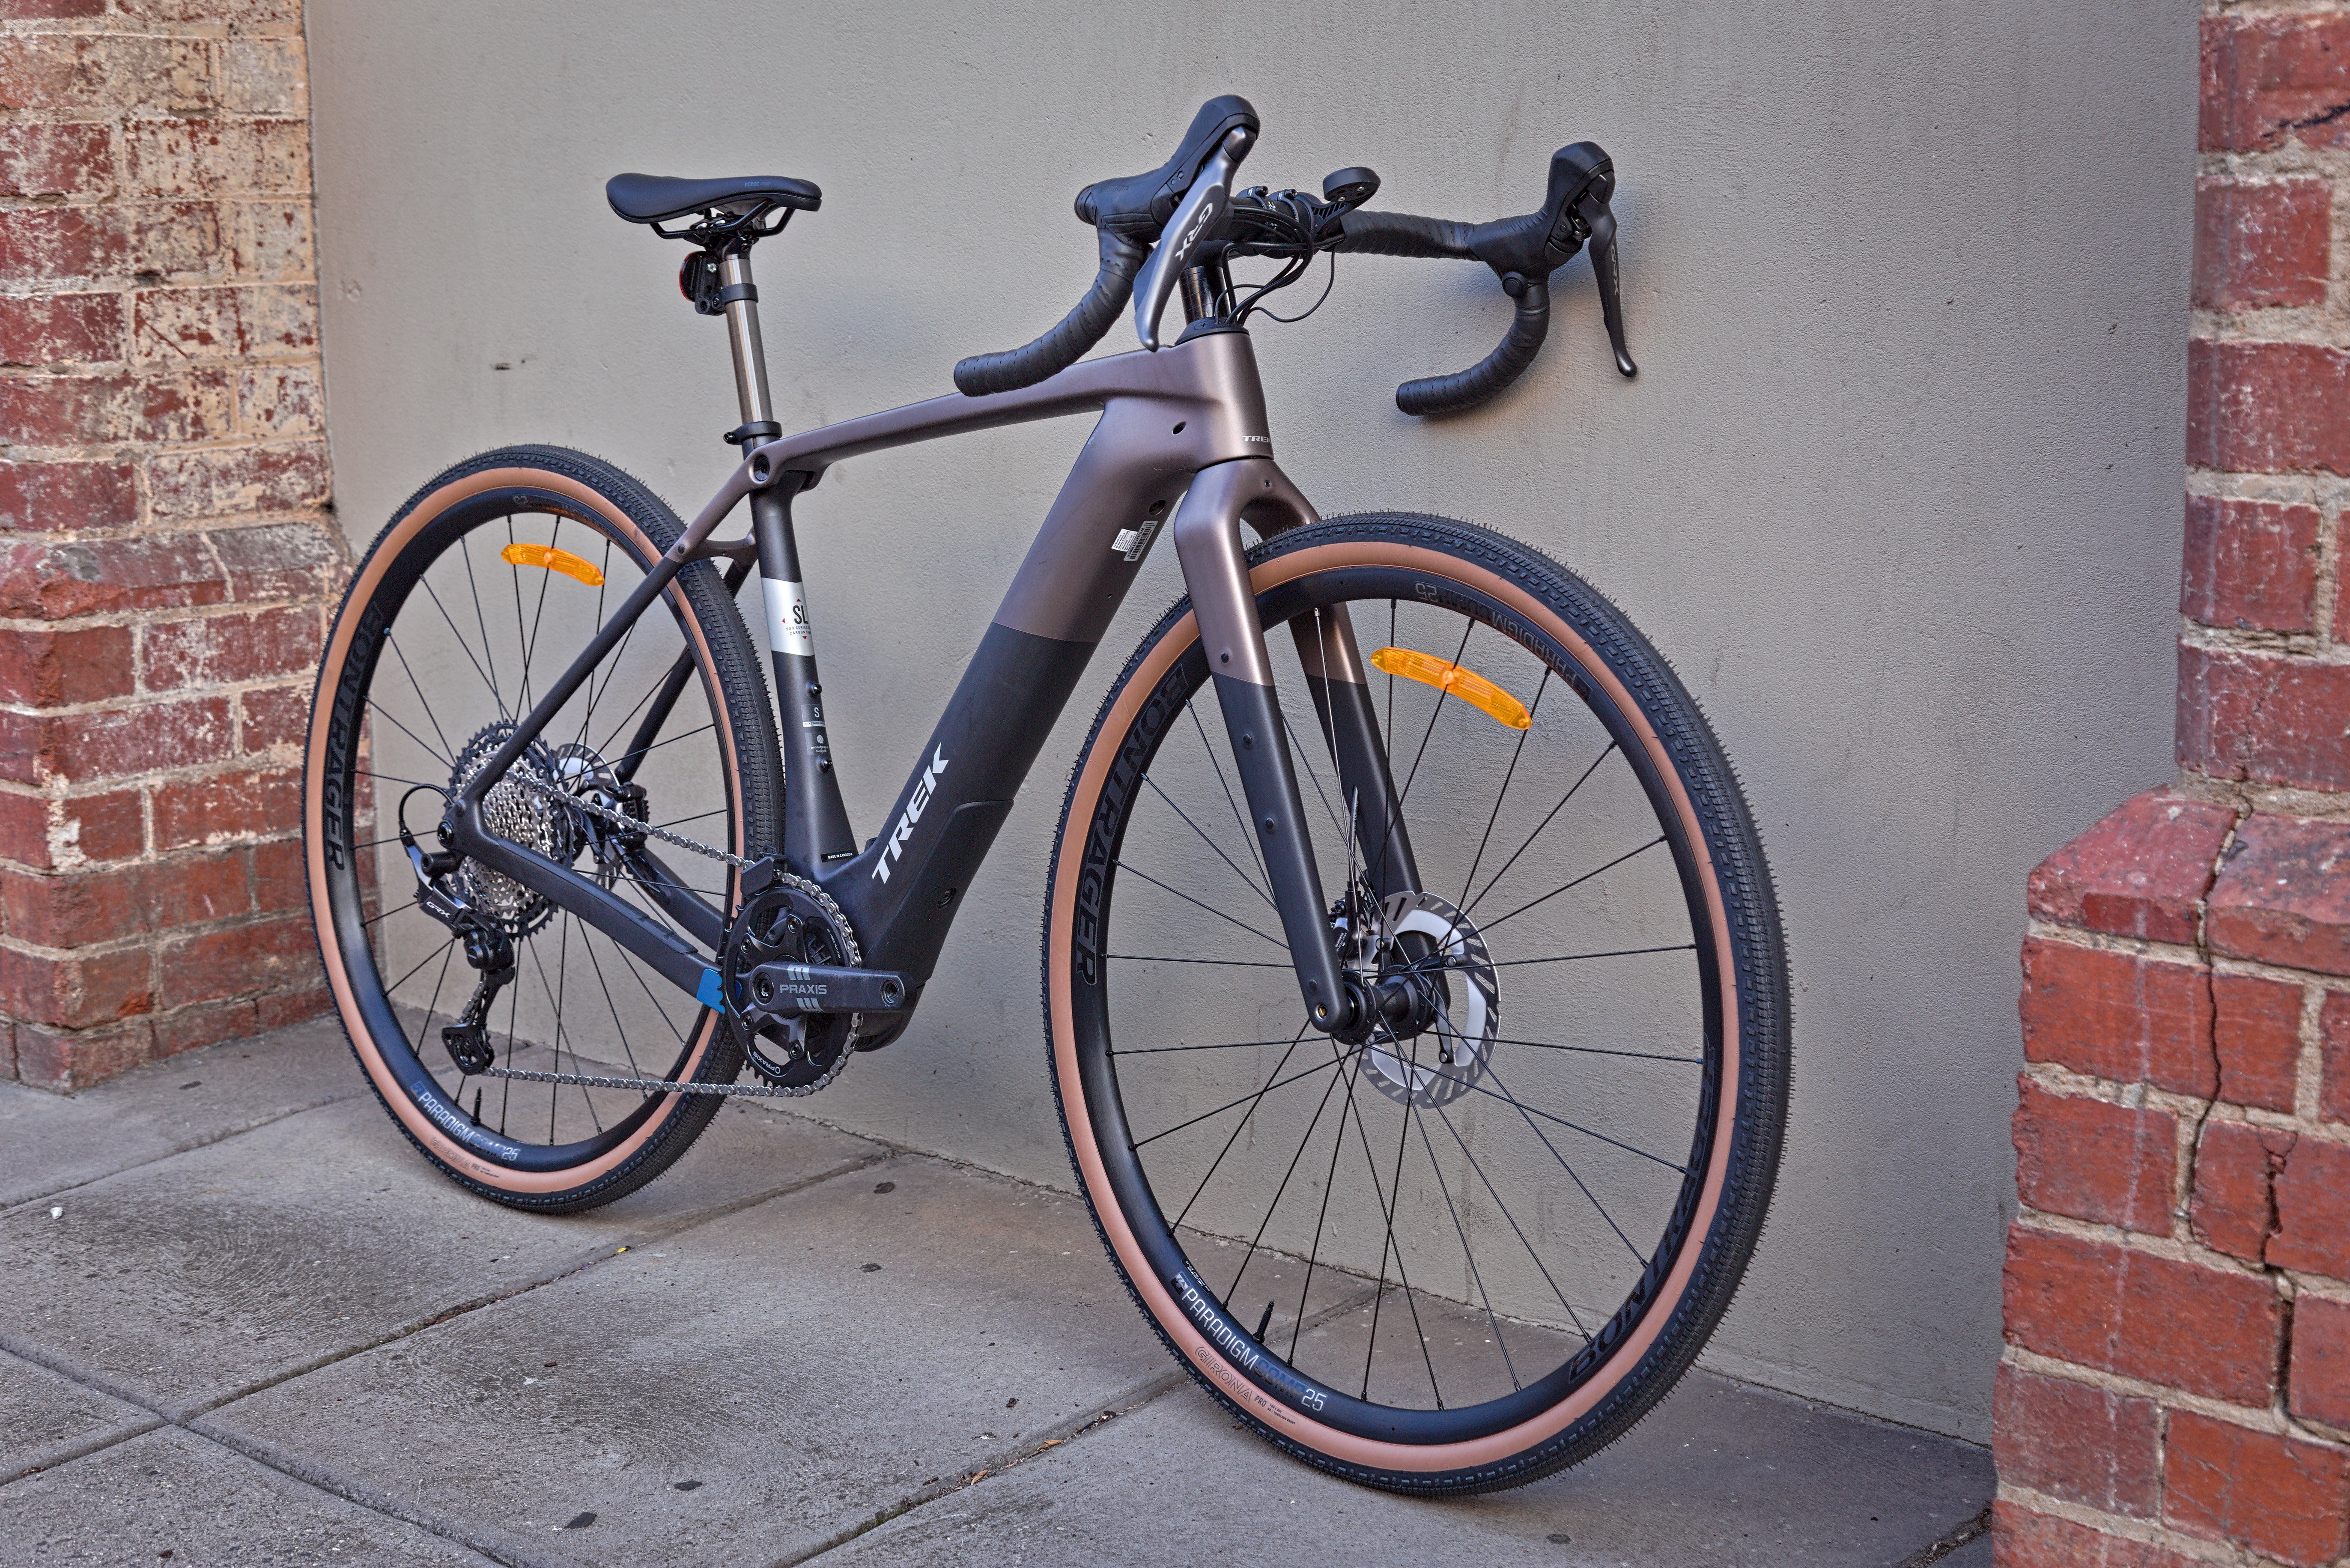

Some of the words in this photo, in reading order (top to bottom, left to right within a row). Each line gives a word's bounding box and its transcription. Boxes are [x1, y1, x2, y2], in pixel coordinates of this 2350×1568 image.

[1175, 203, 1213, 262] GRX
[1611, 244, 1619, 296] GRX
[793, 605, 808, 624] SL
[1416, 582, 1437, 602] 25
[325, 600, 385, 871] BONTRAGER
[814, 707, 820, 718] S
[871, 742, 949, 884] TREK
[1077, 663, 1188, 986] BONTRAGER
[426, 901, 450, 918] GRX
[780, 984, 827, 994] PRAXIS
[753, 1051, 775, 1070] PRAXIS
[418, 1092, 475, 1143] PARADIGM
[501, 1148, 521, 1161] 25
[1182, 1288, 1259, 1370] PARADIGM
[1301, 1389, 1327, 1412] 25
[1195, 1346, 1253, 1403] GIRONA
[1254, 1395, 1267, 1408] PRO
[1274, 1411, 1287, 1420] TUBELESS
